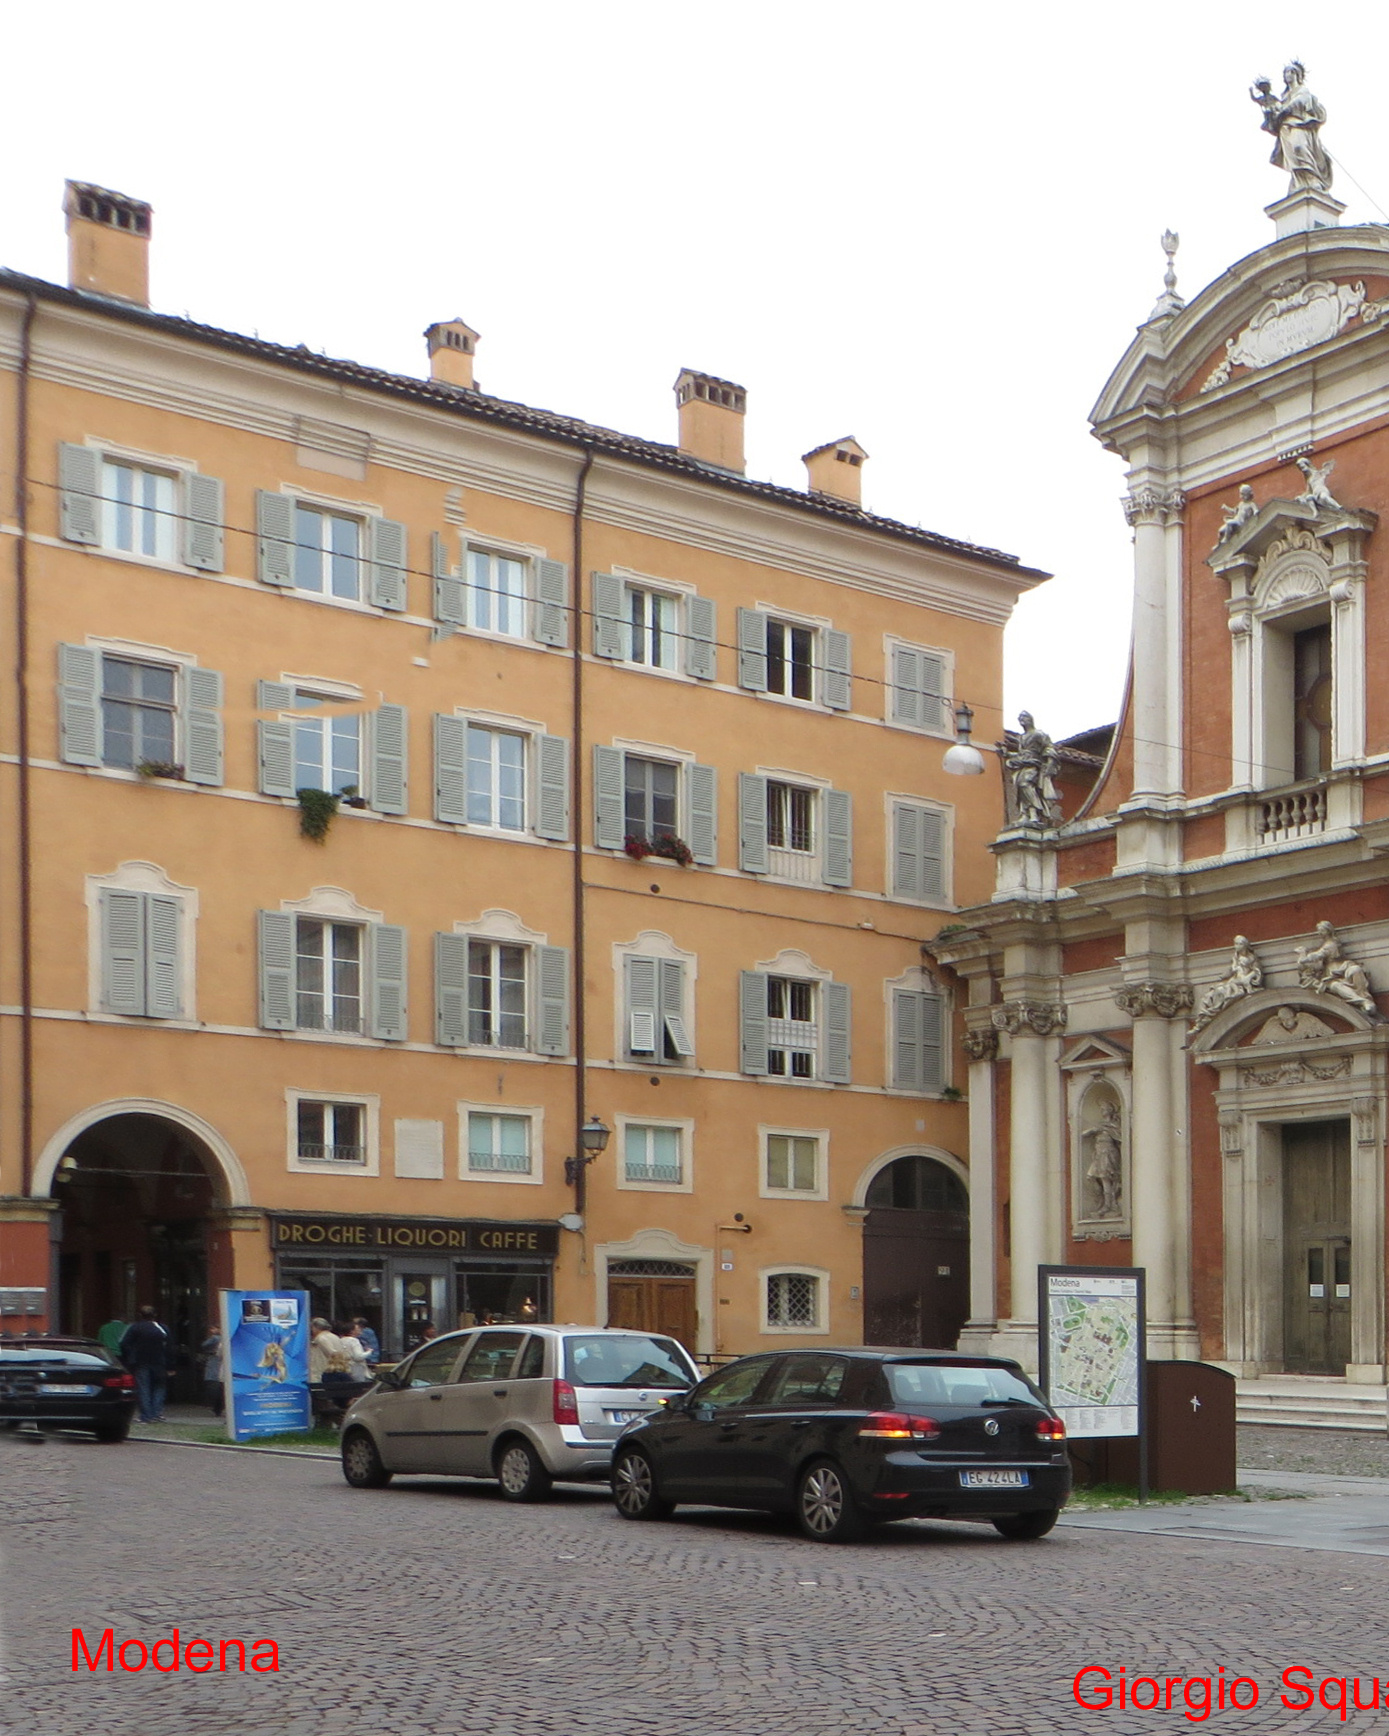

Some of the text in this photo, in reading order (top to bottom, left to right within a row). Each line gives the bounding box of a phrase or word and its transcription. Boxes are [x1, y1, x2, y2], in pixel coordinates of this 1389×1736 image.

[279, 1224, 538, 1250] DROGHE LIQUORI CAFFE
[1050, 1278, 1081, 1288] Modena
[968, 1471, 1021, 1484] EG 424LA
